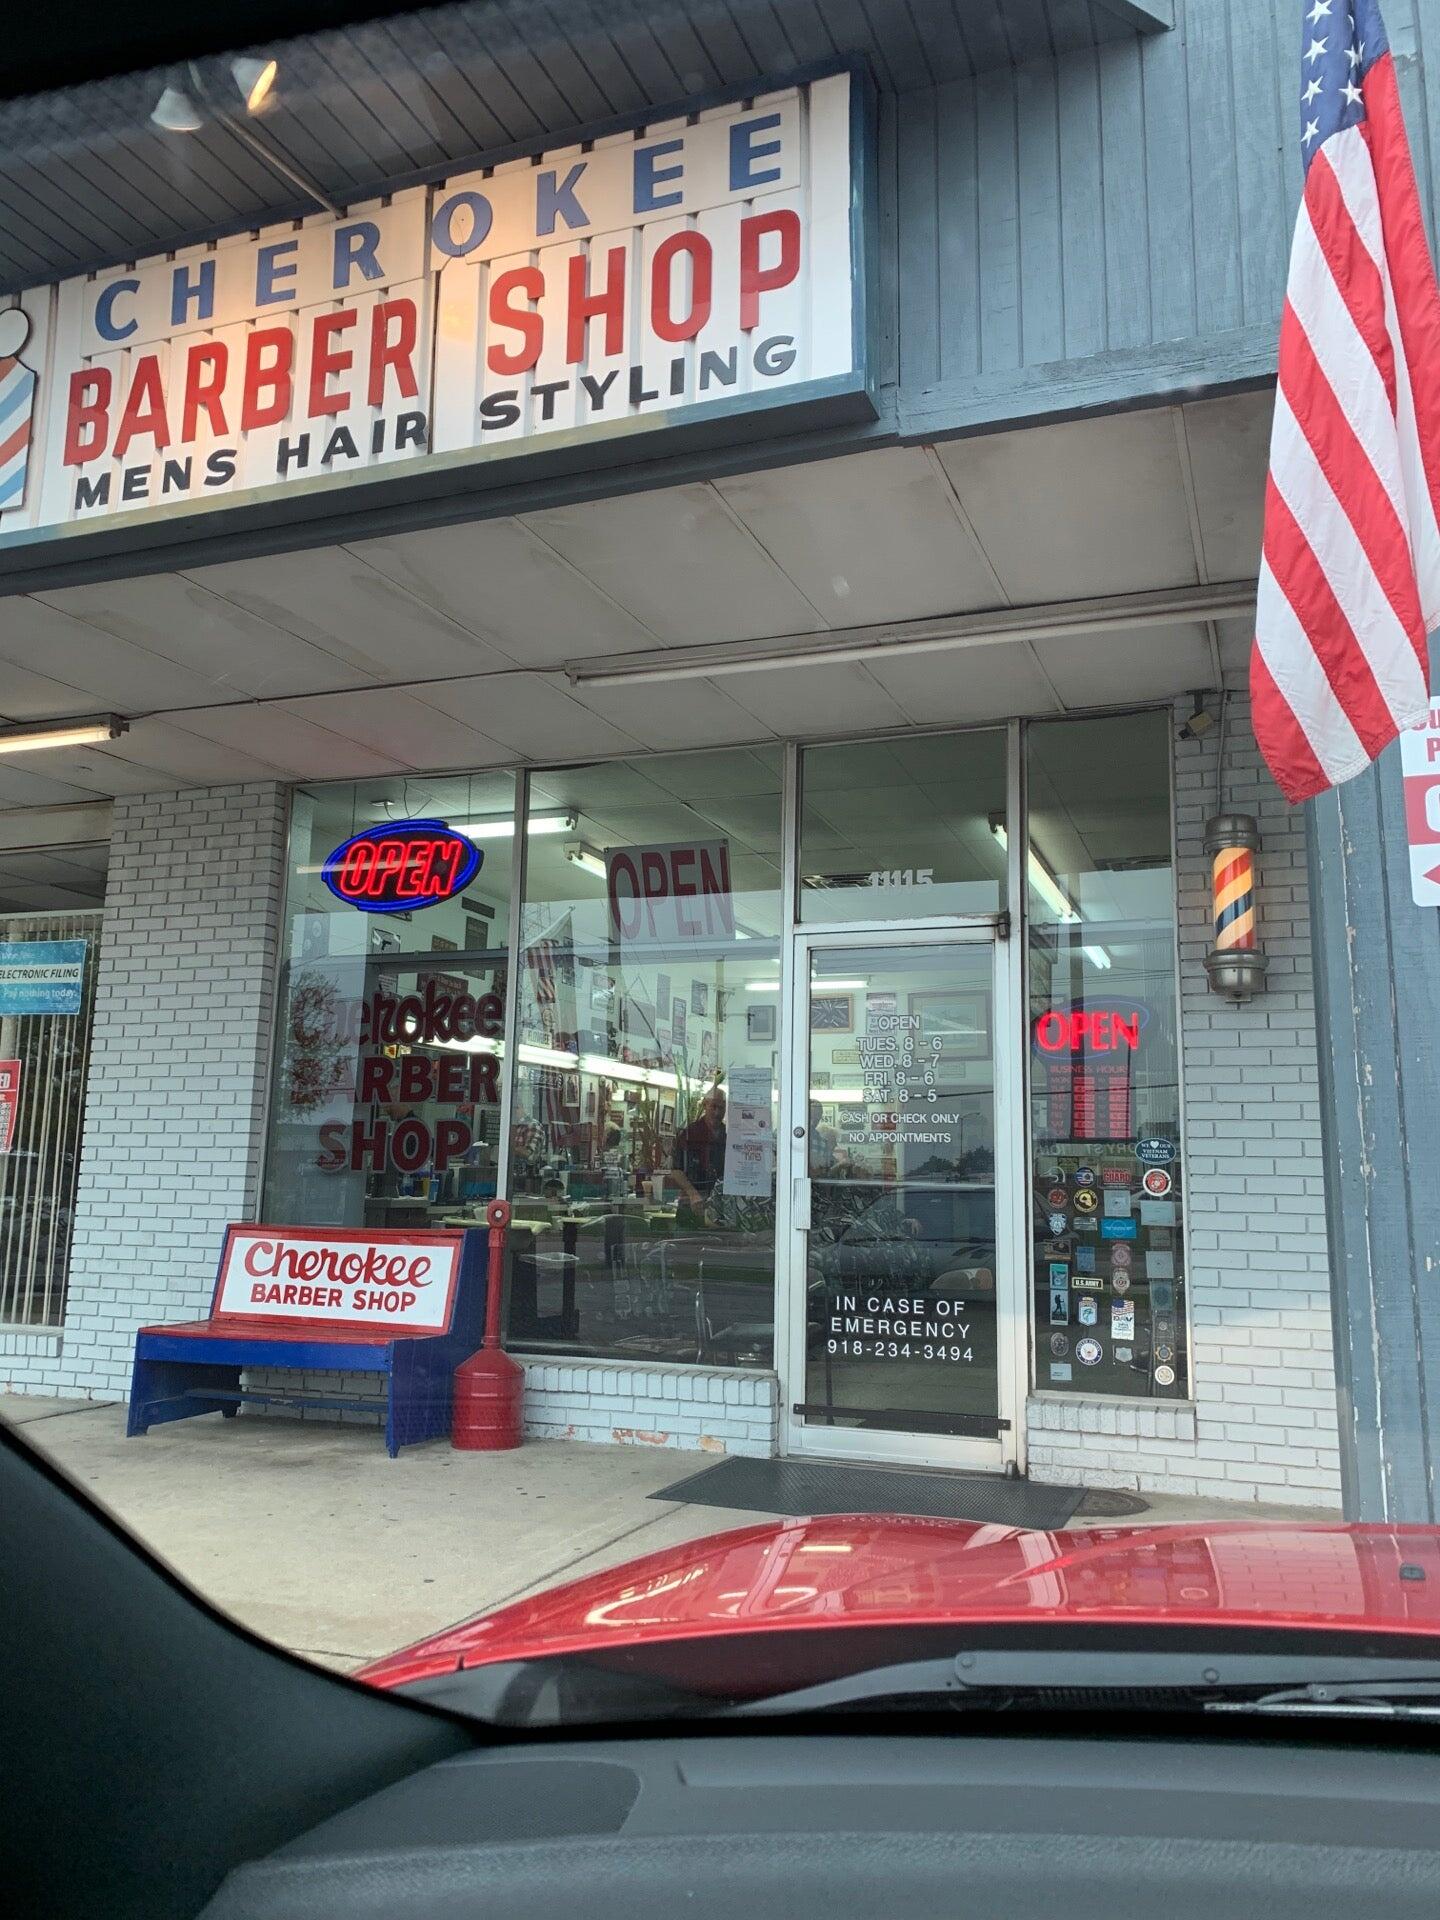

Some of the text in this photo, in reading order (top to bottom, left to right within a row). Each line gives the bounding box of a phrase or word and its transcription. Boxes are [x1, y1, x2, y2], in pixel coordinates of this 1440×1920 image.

[95, 112, 782, 341] CHEROKEE
[63, 208, 801, 467] BARBER SHOP
[74, 335, 797, 512] MENS HAIR STYLING
[340, 840, 463, 896] OPEN
[609, 846, 733, 939] OPEN
[51, 968, 79, 978] FILING
[878, 1015, 920, 1029] OPEN
[1036, 1010, 1139, 1051] OPEN
[857, 1037, 899, 1051] TUES.
[904, 1037, 914, 1050] 8
[932, 1037, 942, 1050] 6
[860, 1054, 897, 1068] WED.
[902, 1055, 912, 1067] 8
[931, 1054, 940, 1067] 7
[865, 1072, 891, 1086] FRI.
[896, 1072, 906, 1085] 8
[924, 1072, 934, 1085] 6
[863, 1089, 894, 1102] SAT.
[899, 1089, 909, 1102] 8
[928, 1089, 937, 1102] 5
[841, 1113, 869, 1123] CASH
[872, 1113, 888, 1123] OR
[891, 1113, 927, 1123] CHECK
[932, 1113, 960, 1124] ONLY
[318, 1119, 474, 1173] SHOP
[850, 1132, 951, 1143] NO APPOINTMENTS
[244, 1241, 433, 1288] Cherokee
[250, 1283, 416, 1312] BARBER SHOP
[836, 1296, 965, 1316] IN CASE OF
[831, 1317, 970, 1339] EMERGENCY
[827, 1340, 974, 1362] 918-234-3494
